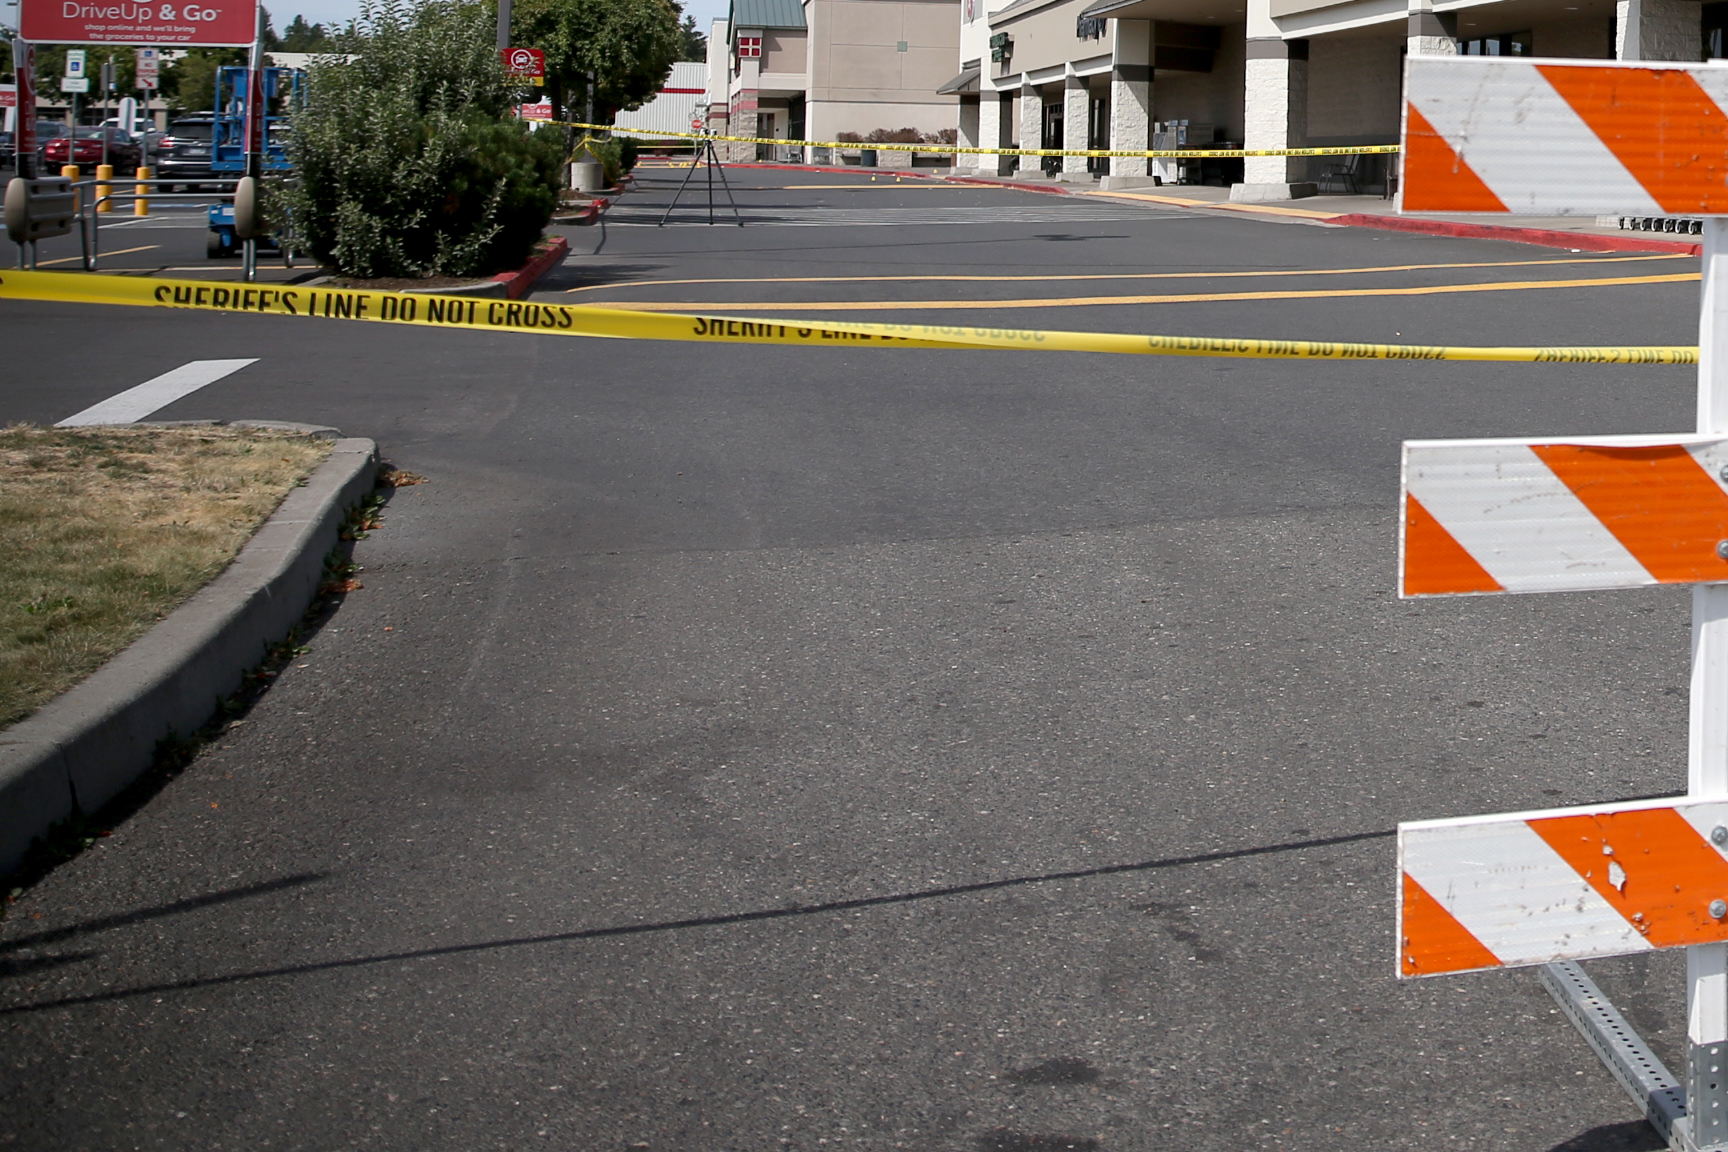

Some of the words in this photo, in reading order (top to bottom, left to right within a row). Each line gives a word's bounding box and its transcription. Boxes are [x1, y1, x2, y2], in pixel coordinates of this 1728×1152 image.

[63, 1, 152, 23] DriveUp
[159, 4, 176, 20] &
[84, 24, 106, 32] shop
[173, 26, 196, 34] bring
[309, 292, 371, 319] LINE
[381, 296, 416, 321] DO
[428, 298, 480, 325] NOT
[488, 302, 574, 329] CROSS
